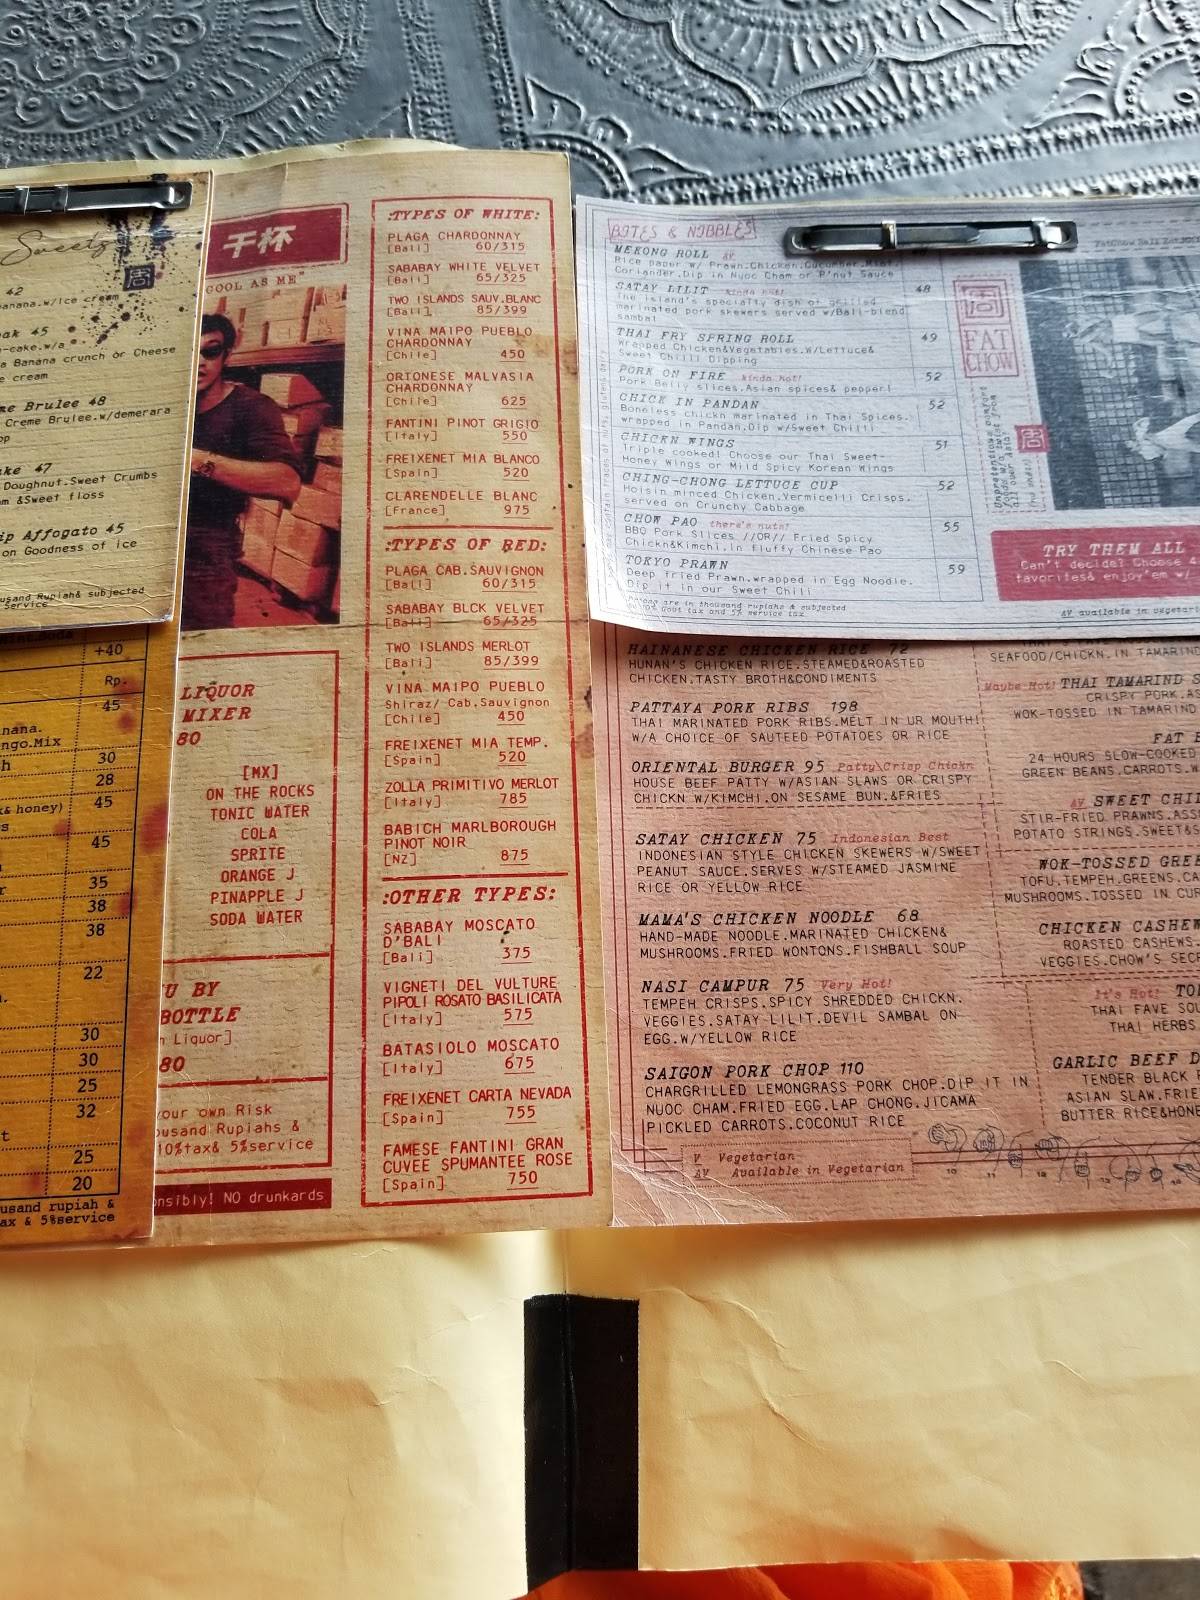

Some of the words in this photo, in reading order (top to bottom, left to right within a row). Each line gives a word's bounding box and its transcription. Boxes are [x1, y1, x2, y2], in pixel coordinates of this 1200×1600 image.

[454, 209, 473, 219] OF
[388, 233, 429, 242] PLAGA
[438, 232, 520, 240] CHARDONNAY
[476, 242, 525, 251] 60/315
[676, 251, 709, 259] ROLL
[388, 264, 440, 273] SABABAY
[450, 263, 486, 272] WHITE
[495, 263, 540, 272] VELVET
[251, 278, 268, 288] AS
[615, 282, 657, 292] SATAY
[6, 287, 23, 296] 42
[31, 328, 48, 336] 45
[617, 327, 651, 338] THAI
[661, 331, 687, 341] FRY
[760, 335, 794, 344] ROLL
[921, 333, 938, 342] 49
[13, 358, 55, 367] Banana
[63, 353, 105, 363] crunch
[134, 346, 176, 357] Cheese
[966, 352, 1013, 372] CHOW
[926, 372, 942, 381] 52
[24, 399, 79, 411] Brulee
[89, 396, 106, 406] 48
[619, 393, 667, 404] CHICK
[676, 397, 693, 406] IN
[702, 399, 760, 409] PANDAN
[386, 419, 438, 429] FANTINI
[448, 418, 485, 428] PINOT
[494, 419, 539, 429] GRIGIO
[503, 431, 527, 441] 550
[688, 438, 735, 448] WINGS
[35, 463, 52, 473] 47
[809, 464, 851, 472] Korean
[859, 464, 895, 472] Wings
[114, 471, 157, 482] Crumbs
[69, 491, 104, 500] floss
[624, 513, 662, 524] CHOW
[671, 517, 698, 527] PAO
[23, 527, 98, 541] Affogato
[106, 523, 124, 534] 45
[943, 522, 960, 532] 55
[794, 534, 829, 542] Fried
[838, 534, 873, 544] Spicy
[25, 544, 83, 555] Goodness
[92, 542, 105, 550] of
[1043, 544, 1077, 557] TRY
[1090, 543, 1140, 556] THEM
[1152, 542, 1185, 554] ALL
[626, 554, 671, 567] TOKYO
[680, 559, 728, 570] PRAWN
[948, 564, 965, 574] 59
[835, 576, 855, 587] Egg
[95, 644, 122, 656] +40
[386, 642, 410, 653] TWO
[421, 642, 474, 652] ISLANDS
[482, 641, 530, 651] MERLOT
[484, 656, 539, 666] 85/399
[1061, 677, 1098, 689] THAI
[180, 684, 255, 702] LIQUOR
[103, 700, 120, 711] 45
[630, 702, 702, 713] PATTAYA
[712, 703, 755, 713] PORK
[766, 702, 809, 712] RIBS
[832, 701, 858, 713] 198
[183, 707, 251, 722] MIXER
[1152, 732, 1184, 744] FAT
[98, 752, 115, 764] 30
[632, 762, 718, 772] ORIENTAL
[729, 761, 794, 772] BURGER
[804, 760, 824, 773] 95
[96, 774, 113, 786] 28
[207, 788, 223, 801] ON
[234, 786, 260, 799] THE
[270, 785, 315, 797] ROCKS
[1094, 794, 1151, 807] SWEET
[211, 806, 254, 820] TONIC
[265, 805, 309, 818] WATER
[241, 827, 277, 840] COLA
[384, 824, 441, 835] BABICH
[452, 820, 556, 832] MARLBOROUGH
[384, 837, 425, 849] PINOT
[433, 837, 466, 848] NOIR
[636, 833, 689, 845] SATAY
[700, 833, 783, 845] CHICKEN
[797, 832, 816, 845] 75
[832, 833, 910, 844] Indonesian
[918, 832, 950, 842] Best
[231, 847, 285, 861] SPRITE
[501, 850, 529, 861] 875
[1039, 856, 1150, 870] WOK-TOSSED
[221, 868, 275, 883] ORANGE
[89, 876, 108, 889] 35
[638, 882, 671, 892] RICE
[682, 882, 699, 892] OR
[709, 882, 760, 892] YELLOW
[769, 881, 802, 892] RICE
[211, 889, 284, 904] PINAPPLE
[88, 900, 106, 912] 38
[210, 912, 246, 926] SODA
[257, 910, 302, 924] WATER
[639, 912, 701, 926] MAMA'S
[713, 912, 797, 925] CHICKEN
[809, 910, 874, 924] NOODLE
[898, 909, 919, 922] 68
[1039, 921, 1121, 935] CHICKEN
[84, 966, 103, 980] 22
[641, 980, 687, 993] NASI
[700, 979, 769, 992] CAMPUR
[785, 978, 805, 992] 75
[821, 980, 852, 991] Very
[1109, 1022, 1142, 1033] THAI
[1153, 1020, 1196, 1031] HERBS
[1053, 1055, 1118, 1069] GARLIC
[1130, 1053, 1178, 1067] BEEF
[645, 1066, 713, 1080] SAIGON
[725, 1065, 771, 1078] PORK
[783, 1063, 829, 1077] CHOP
[841, 1062, 864, 1075] 110
[78, 1079, 97, 1092] 25
[383, 1091, 461, 1106] FREIXENET
[469, 1089, 512, 1102] CARTA
[521, 1086, 572, 1100] NEVADA
[76, 1104, 96, 1118] 32
[199, 1106, 225, 1117] own
[237, 1104, 272, 1116] Risk
[507, 1106, 535, 1118] 755
[217, 1122, 281, 1136] Rupiahs
[719, 1152, 795, 1163] Vegetarian
[732, 1167, 799, 1177] Available
[807, 1167, 819, 1175] in
[828, 1163, 904, 1176] Vegetarian
[72, 1176, 92, 1190] 20
[224, 1191, 240, 1204] NO
[250, 1190, 324, 1203] drunkards
[49, 1201, 97, 1212] rupiah
[107, 1199, 114, 1209] &
